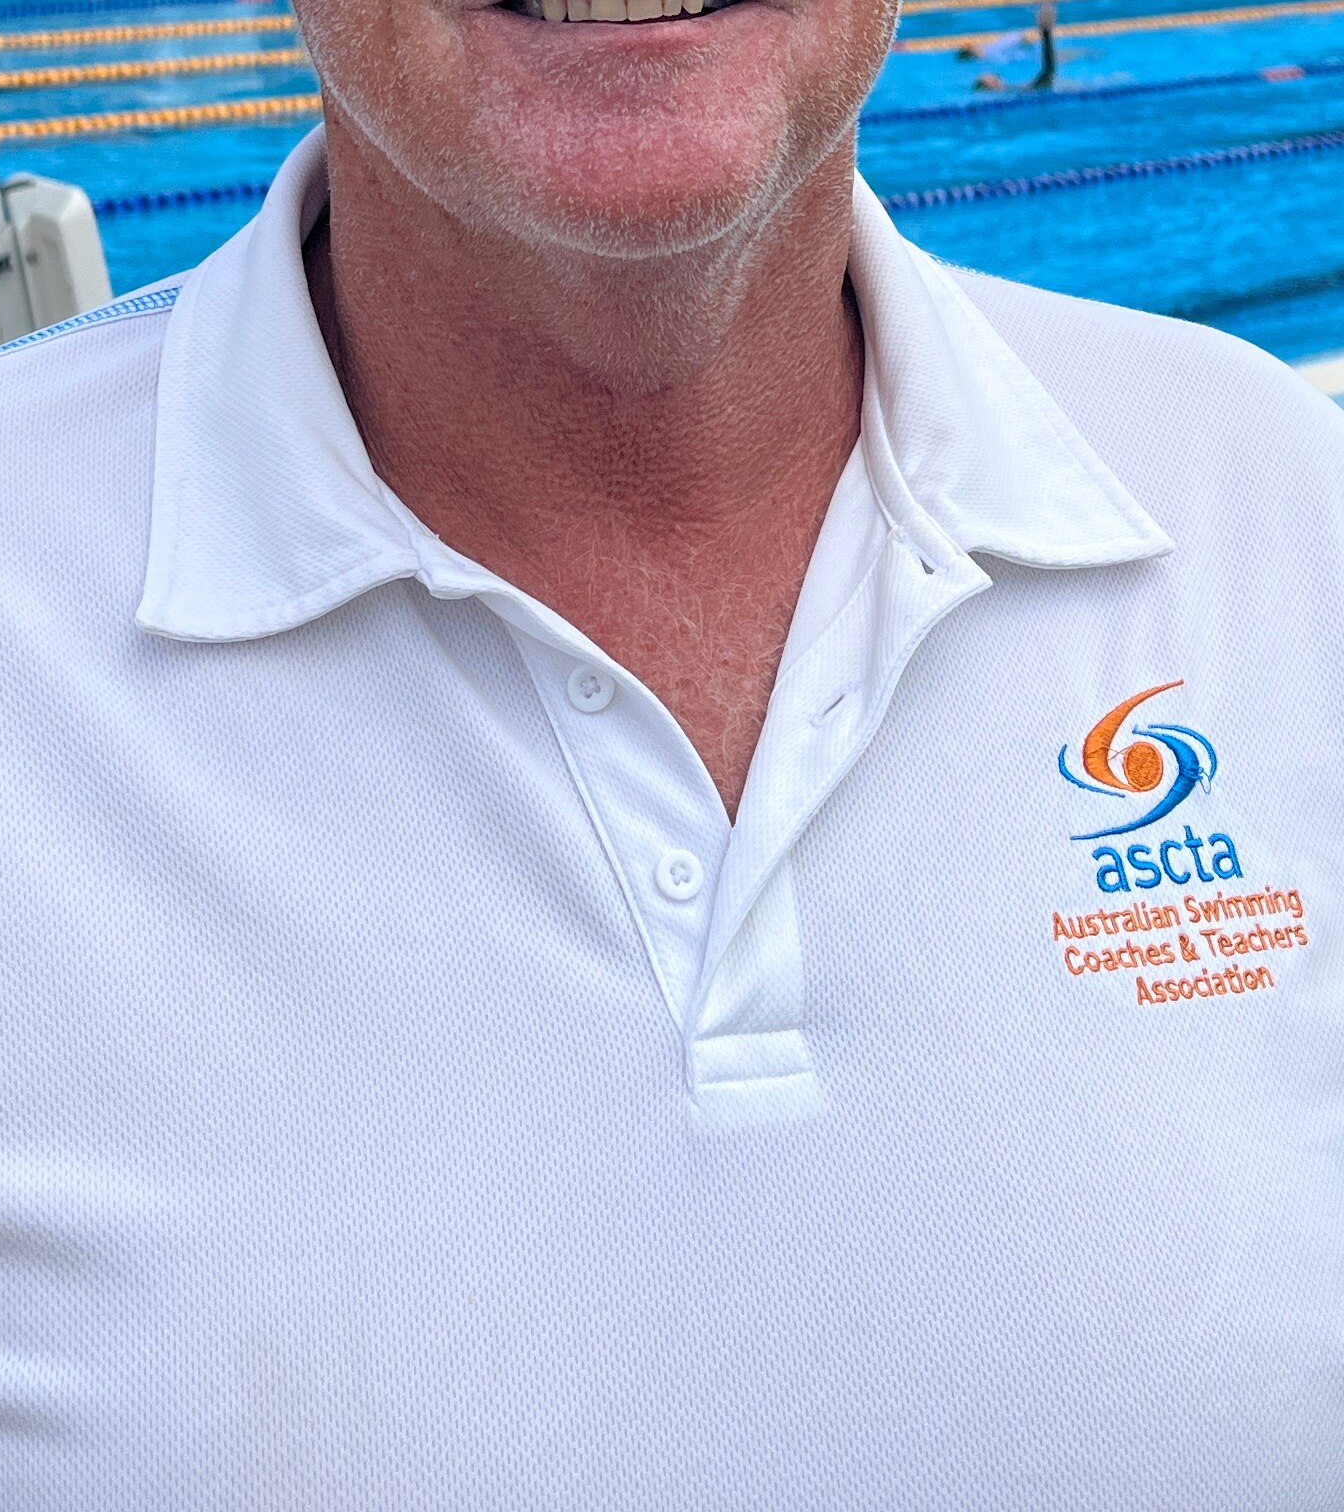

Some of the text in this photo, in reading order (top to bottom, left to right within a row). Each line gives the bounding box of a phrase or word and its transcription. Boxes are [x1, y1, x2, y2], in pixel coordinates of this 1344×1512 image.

[1092, 825, 1243, 893] ascta
[1052, 886, 1303, 942] Australian Swimming
[1064, 924, 1308, 977] Coaches & Teachers
[1136, 965, 1274, 1005] Association
